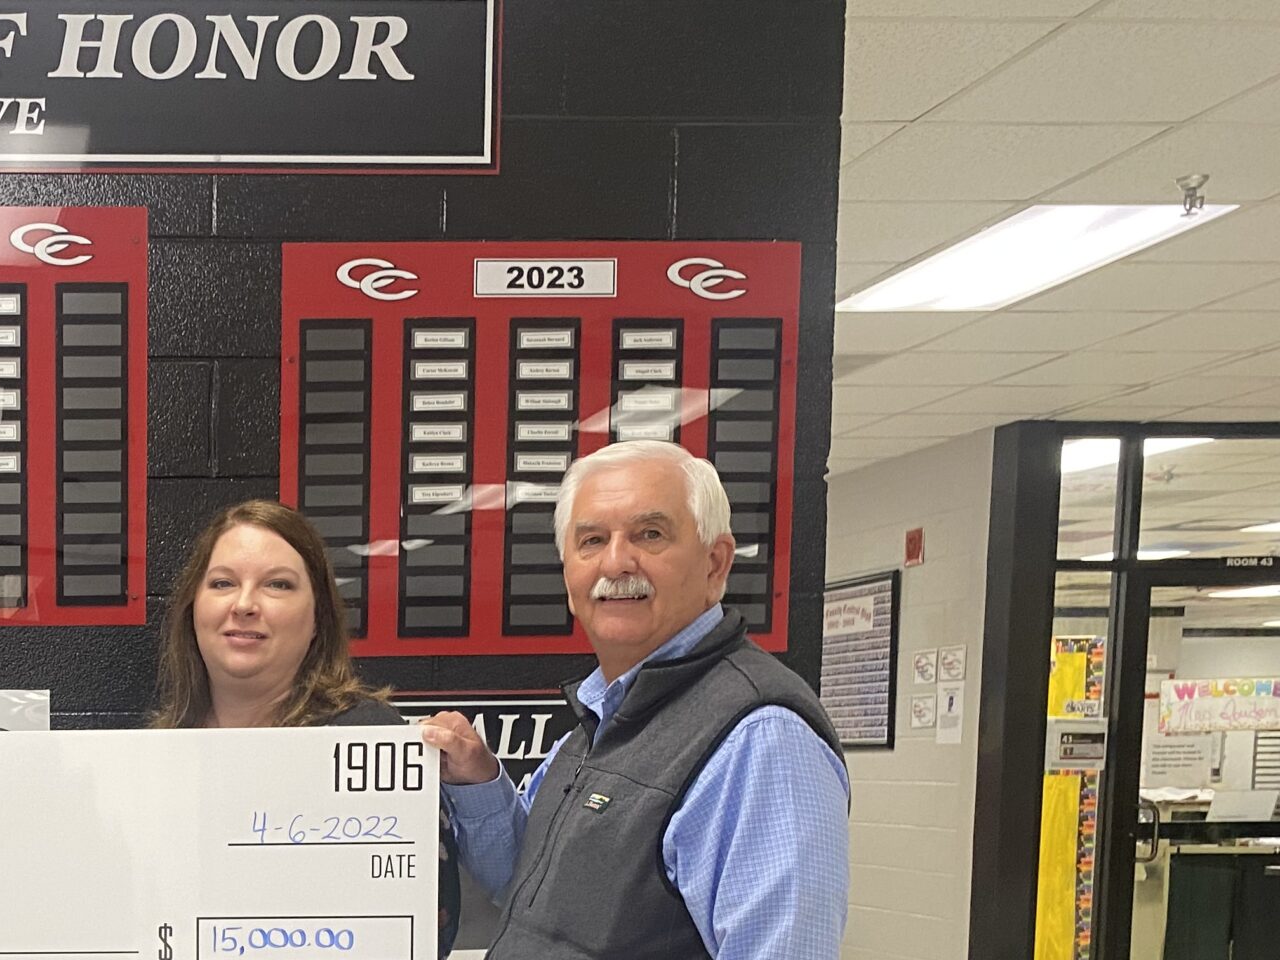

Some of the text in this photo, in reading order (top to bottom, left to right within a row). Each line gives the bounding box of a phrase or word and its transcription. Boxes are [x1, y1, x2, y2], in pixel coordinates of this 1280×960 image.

[47, 12, 414, 84] HONOR
[506, 266, 585, 290] 2023
[1226, 558, 1258, 566] ROOM
[332, 741, 424, 793] 1906
[251, 810, 404, 844] 4-6-2022
[370, 853, 417, 880] DATE
[210, 925, 356, 956] 15,000.00
